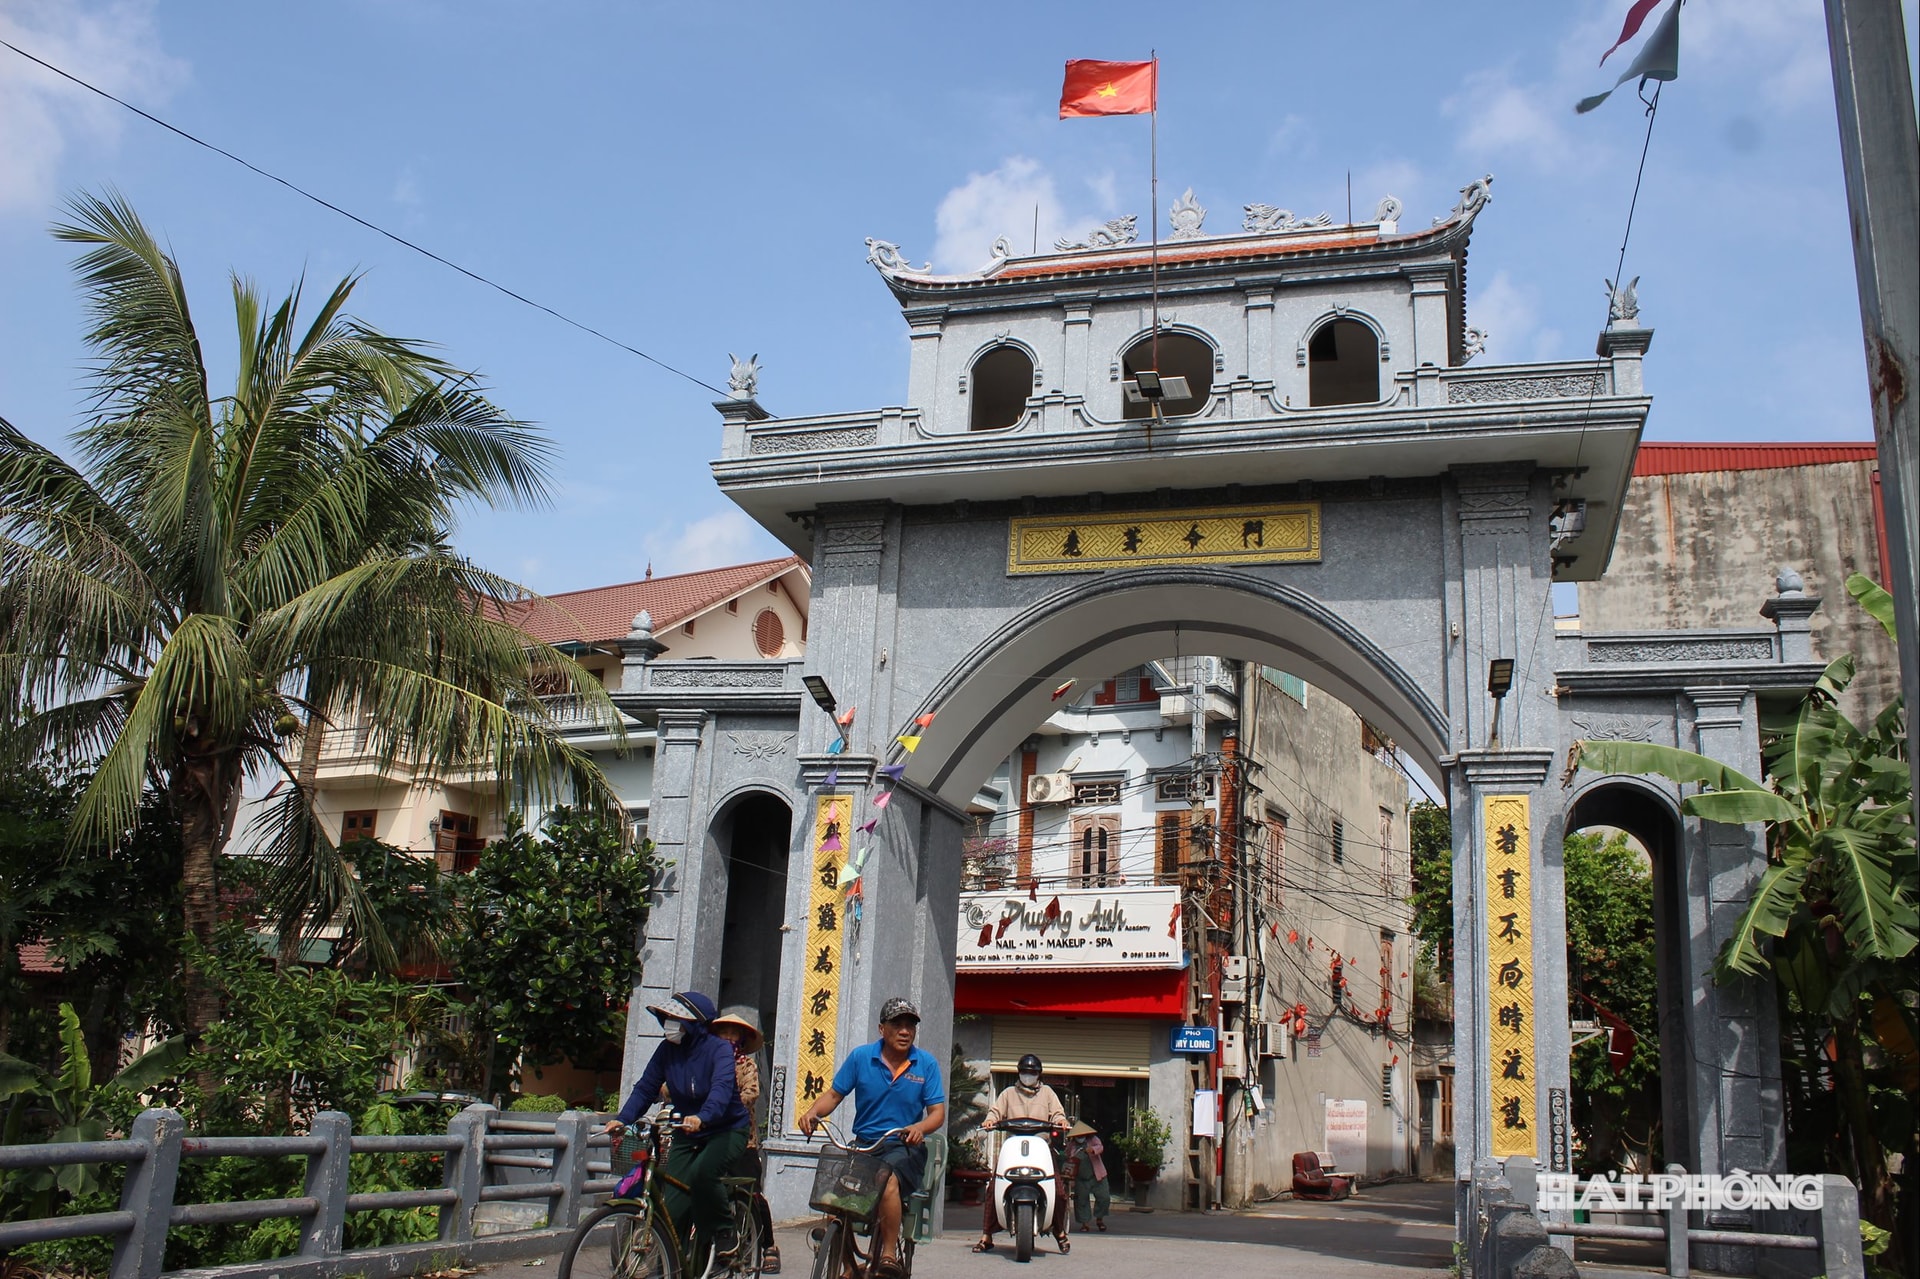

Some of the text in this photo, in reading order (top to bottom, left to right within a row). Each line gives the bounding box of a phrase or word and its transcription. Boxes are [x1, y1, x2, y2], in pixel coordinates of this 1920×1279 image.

[1079, 899, 1127, 931] Anh
[996, 939, 1016, 949] NAIL
[1047, 938, 1086, 948] MAKEUP
[1096, 937, 1113, 947] SPA
[1175, 1037, 1211, 1049] MỸ LONG
